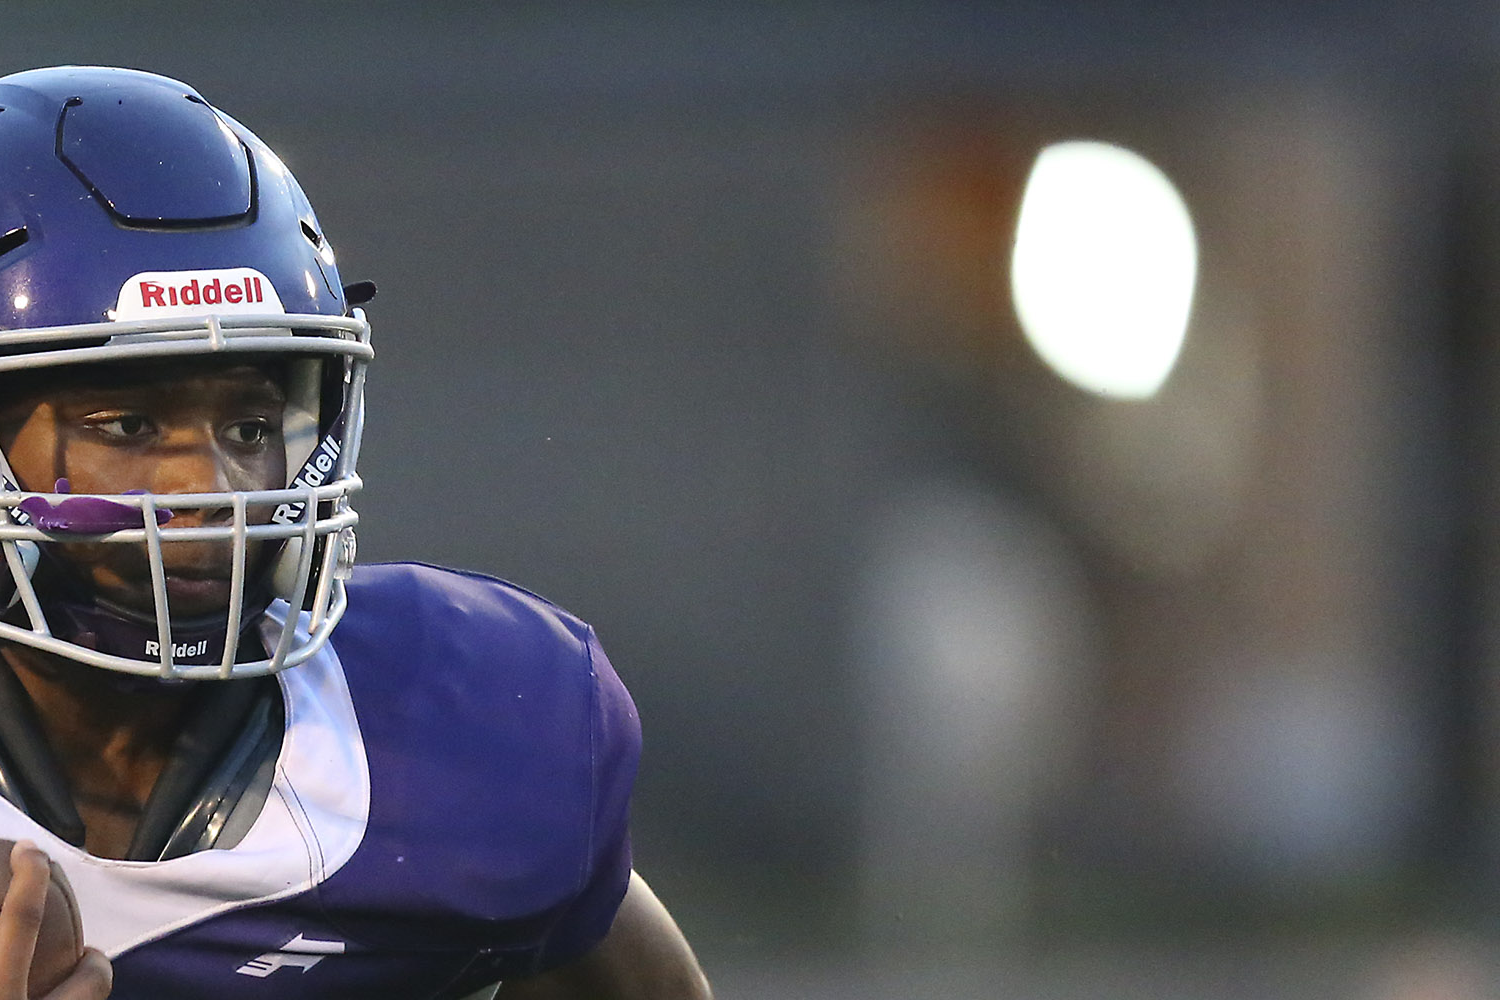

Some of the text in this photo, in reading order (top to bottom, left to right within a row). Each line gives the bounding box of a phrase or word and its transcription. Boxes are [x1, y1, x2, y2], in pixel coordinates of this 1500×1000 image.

[139, 277, 263, 307] Riddell
[271, 434, 341, 524] Rdell
[145, 640, 208, 658] Rdell
